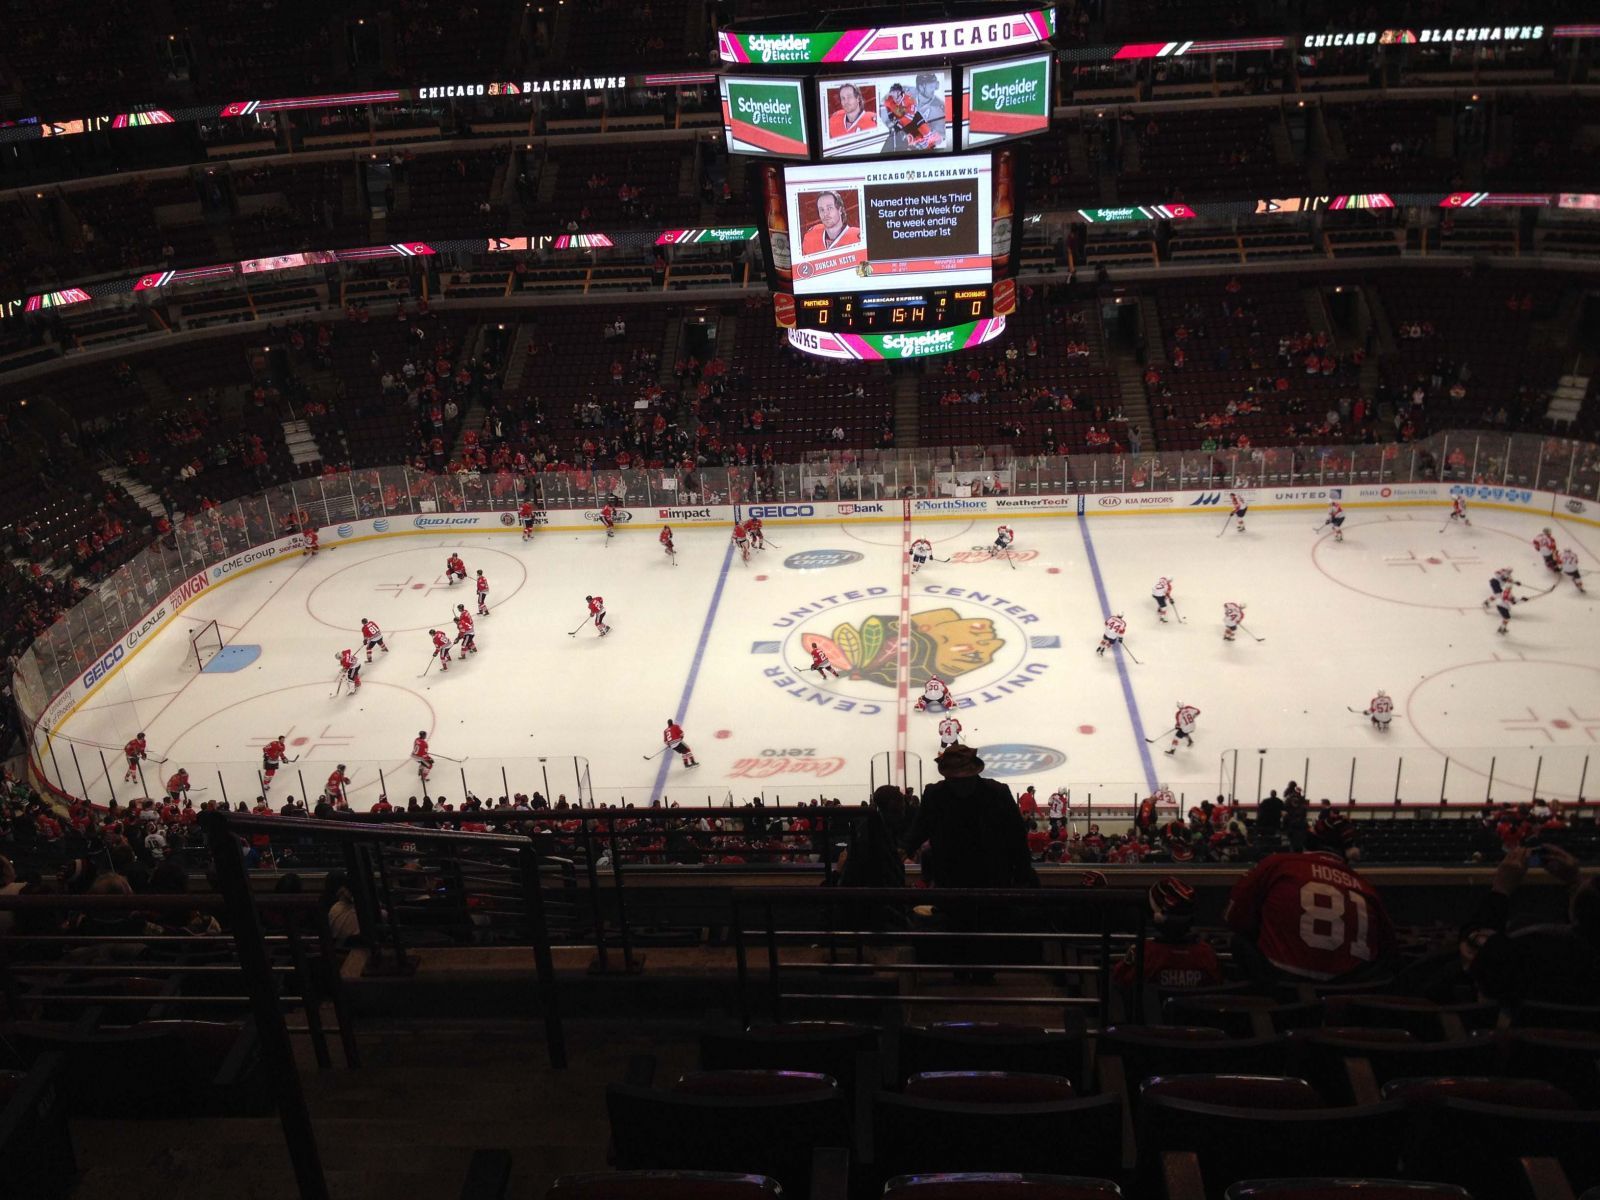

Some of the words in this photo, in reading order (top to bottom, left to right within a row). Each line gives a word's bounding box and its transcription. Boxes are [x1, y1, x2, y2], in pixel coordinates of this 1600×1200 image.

[749, 35, 811, 52] Schneider
[901, 23, 1012, 50] CHICAGO
[1304, 32, 1377, 47] CHICAGO
[1419, 25, 1544, 42] BLACKHAWKS
[772, 50, 811, 61] Electric
[419, 84, 484, 99] CHICAGO
[522, 76, 627, 93] BLACKHAWKS
[981, 78, 1038, 101] Schneider
[738, 98, 792, 116] Schneider
[1004, 93, 1037, 107] Electric
[761, 113, 792, 126] Electric
[866, 171, 906, 182] CHICAGO
[916, 167, 979, 179] BLACKHAWKS
[870, 197, 903, 208] Named
[904, 196, 920, 206] the
[920, 194, 948, 205] NHL's
[948, 192, 972, 203] Third
[878, 208, 897, 218] Star
[898, 207, 909, 217] of
[909, 206, 924, 216] the
[925, 205, 951, 215] Week
[951, 204, 965, 214] for
[1097, 208, 1134, 219] Schneider
[886, 218, 901, 229] the
[902, 217, 926, 228] week
[926, 216, 958, 229] ending
[710, 229, 745, 240] Schneider
[892, 228, 937, 240] December
[939, 228, 952, 238] 1st
[802, 265, 809, 275] 2
[815, 259, 838, 271] DUNCAN
[838, 254, 857, 265] KEITH
[863, 296, 895, 304] AMERICAN
[896, 295, 924, 303] EXPRESS
[971, 301, 982, 316] 0
[819, 309, 828, 324] 0
[882, 331, 954, 352] Schneider
[914, 343, 953, 355] Electric
[996, 498, 1069, 507] WeatherTech
[1140, 496, 1174, 504] MOTORS
[1275, 491, 1326, 501] UNITED
[749, 504, 815, 518] GEICO
[922, 499, 988, 511] NorthShore
[668, 508, 711, 520] impact
[222, 557, 243, 574] CME
[244, 547, 276, 564] Group
[180, 572, 209, 599] WGN
[772, 586, 889, 629] UNITED
[924, 584, 1039, 625] CENTER
[137, 608, 166, 638] LEXUS
[83, 644, 124, 689] GEICO
[763, 666, 881, 715] CENTER
[760, 748, 817, 758] zero
[1311, 864, 1362, 889] HOSSA
[1300, 881, 1371, 962] 81
[1160, 970, 1201, 987] SHARP
